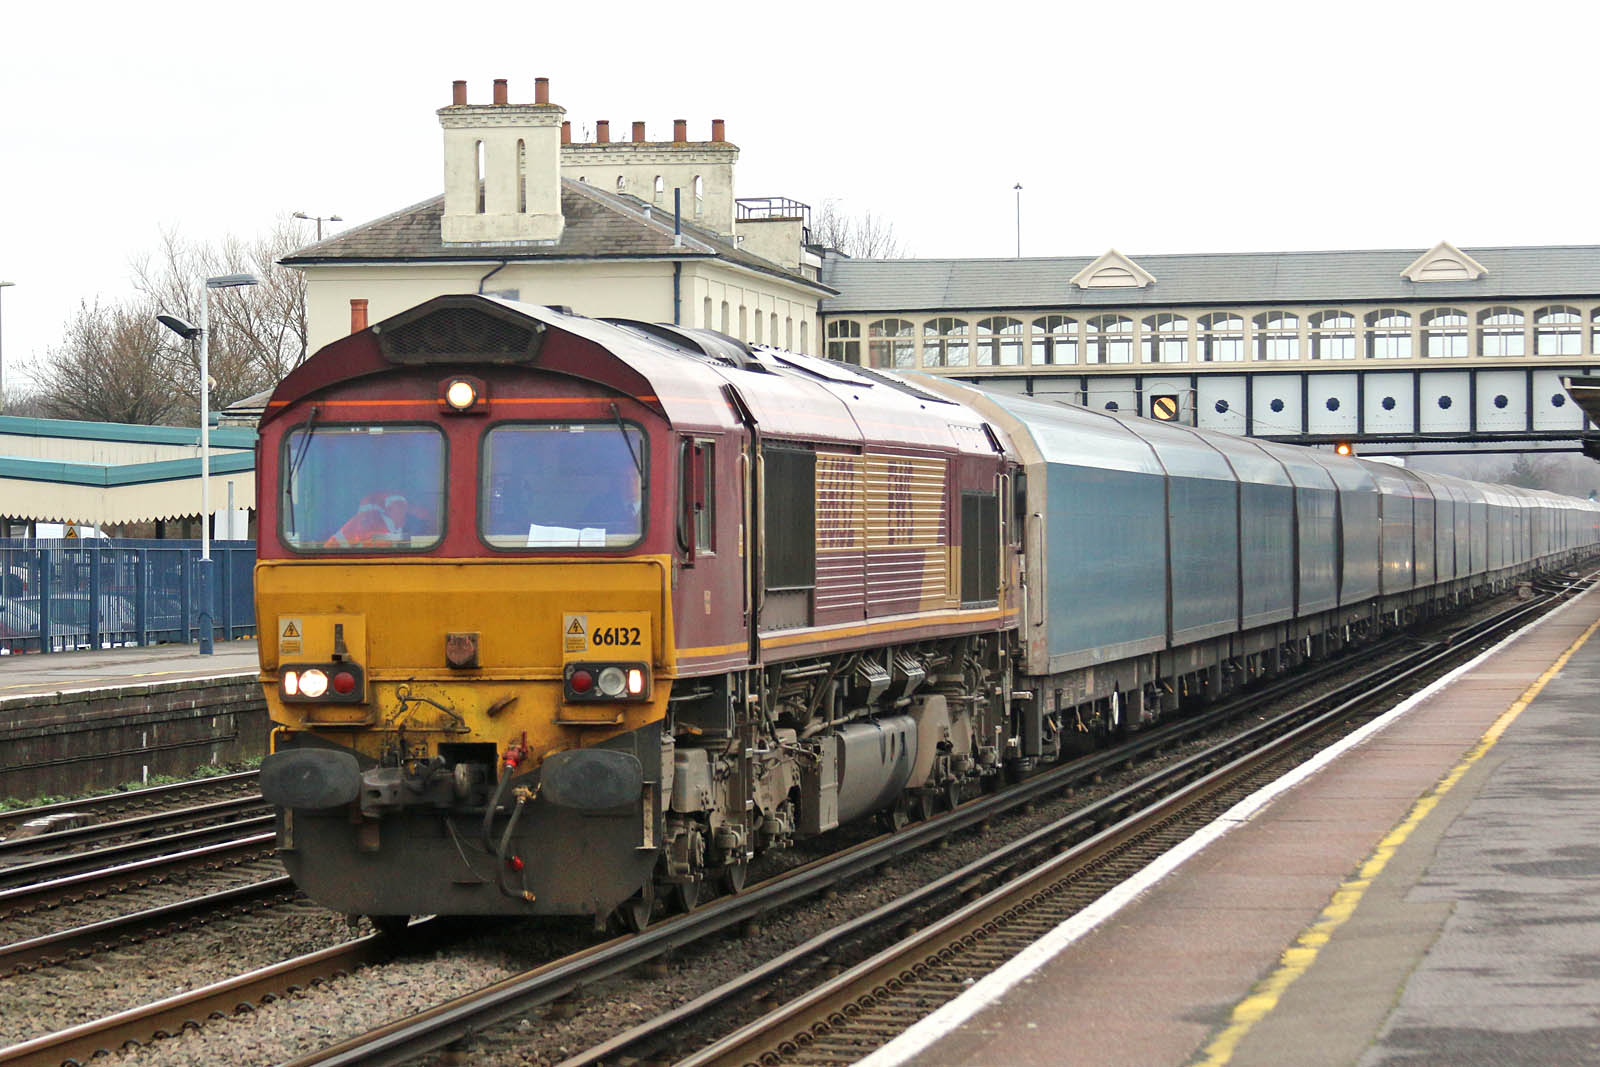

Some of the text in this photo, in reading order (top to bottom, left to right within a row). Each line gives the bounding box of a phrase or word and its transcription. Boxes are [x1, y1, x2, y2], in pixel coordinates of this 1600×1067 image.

[820, 457, 914, 548] 66132 EWS
[592, 627, 641, 646] 66132
